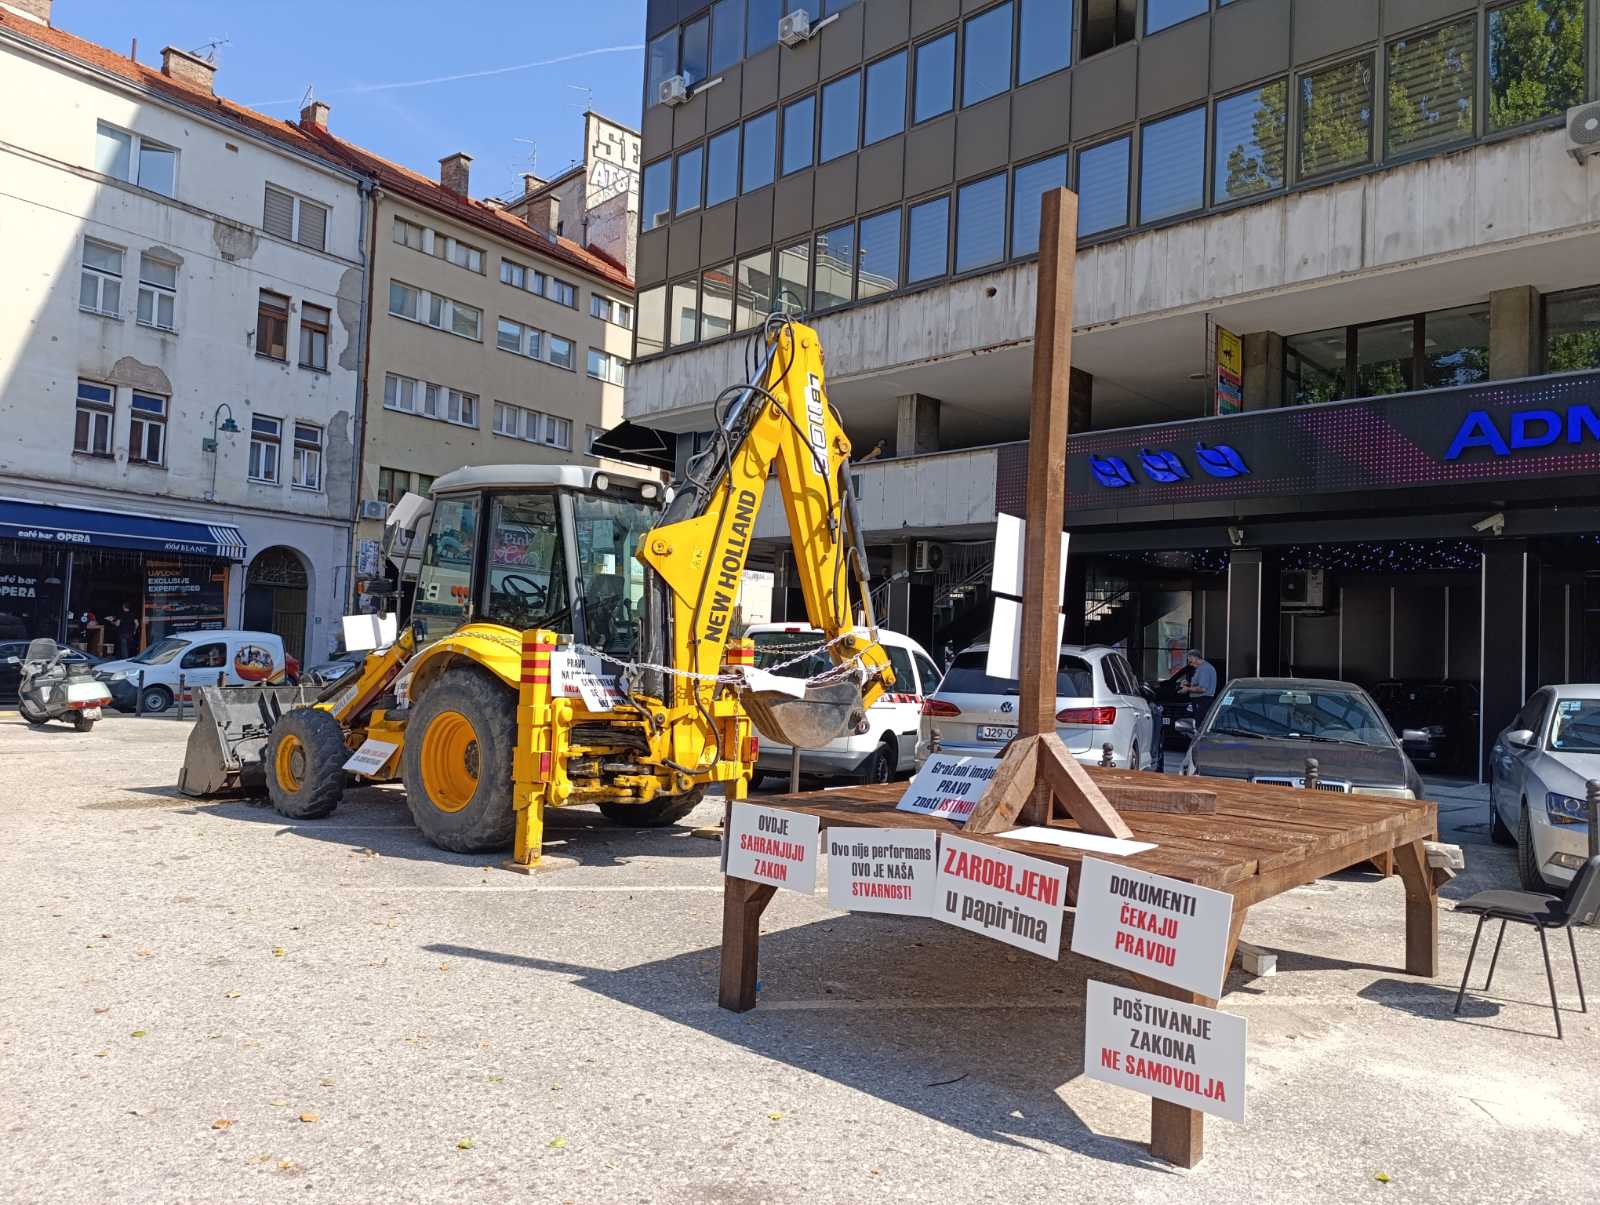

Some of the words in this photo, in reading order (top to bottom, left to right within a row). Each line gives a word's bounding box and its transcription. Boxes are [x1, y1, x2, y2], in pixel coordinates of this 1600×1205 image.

[57, 532, 91, 543] OPERA
[181, 544, 207, 553] BLANC
[705, 591, 731, 643] NEW
[718, 490, 756, 589] HOLLAND
[18, 576, 37, 585] bar
[936, 780, 972, 795] PRAVO
[912, 796, 941, 810] znati
[758, 815, 789, 836] OVDJE
[740, 833, 805, 862] SAHRANJUJU
[831, 842, 850, 857] Ovo
[852, 843, 869, 860] nije
[871, 844, 932, 861] performans
[754, 859, 787, 881] ZAKON
[851, 862, 870, 877] OVO
[873, 864, 884, 878] JE
[887, 862, 914, 880] NAŠA
[943, 847, 1060, 907] ZAROBLJENI
[852, 882, 912, 900] STVARNOST!
[1109, 875, 1197, 917] DOKUMENTI
[946, 890, 958, 914] u
[962, 895, 1048, 944] papirima
[1119, 902, 1179, 940] ČEKAJU
[1115, 931, 1177, 968] PRAVDU
[1113, 996, 1212, 1040] POŠTIVANJE
[1130, 1028, 1196, 1065] ZAKONA
[1101, 1047, 1121, 1071] NE
[1125, 1054, 1226, 1102] SAMOVOLJA
